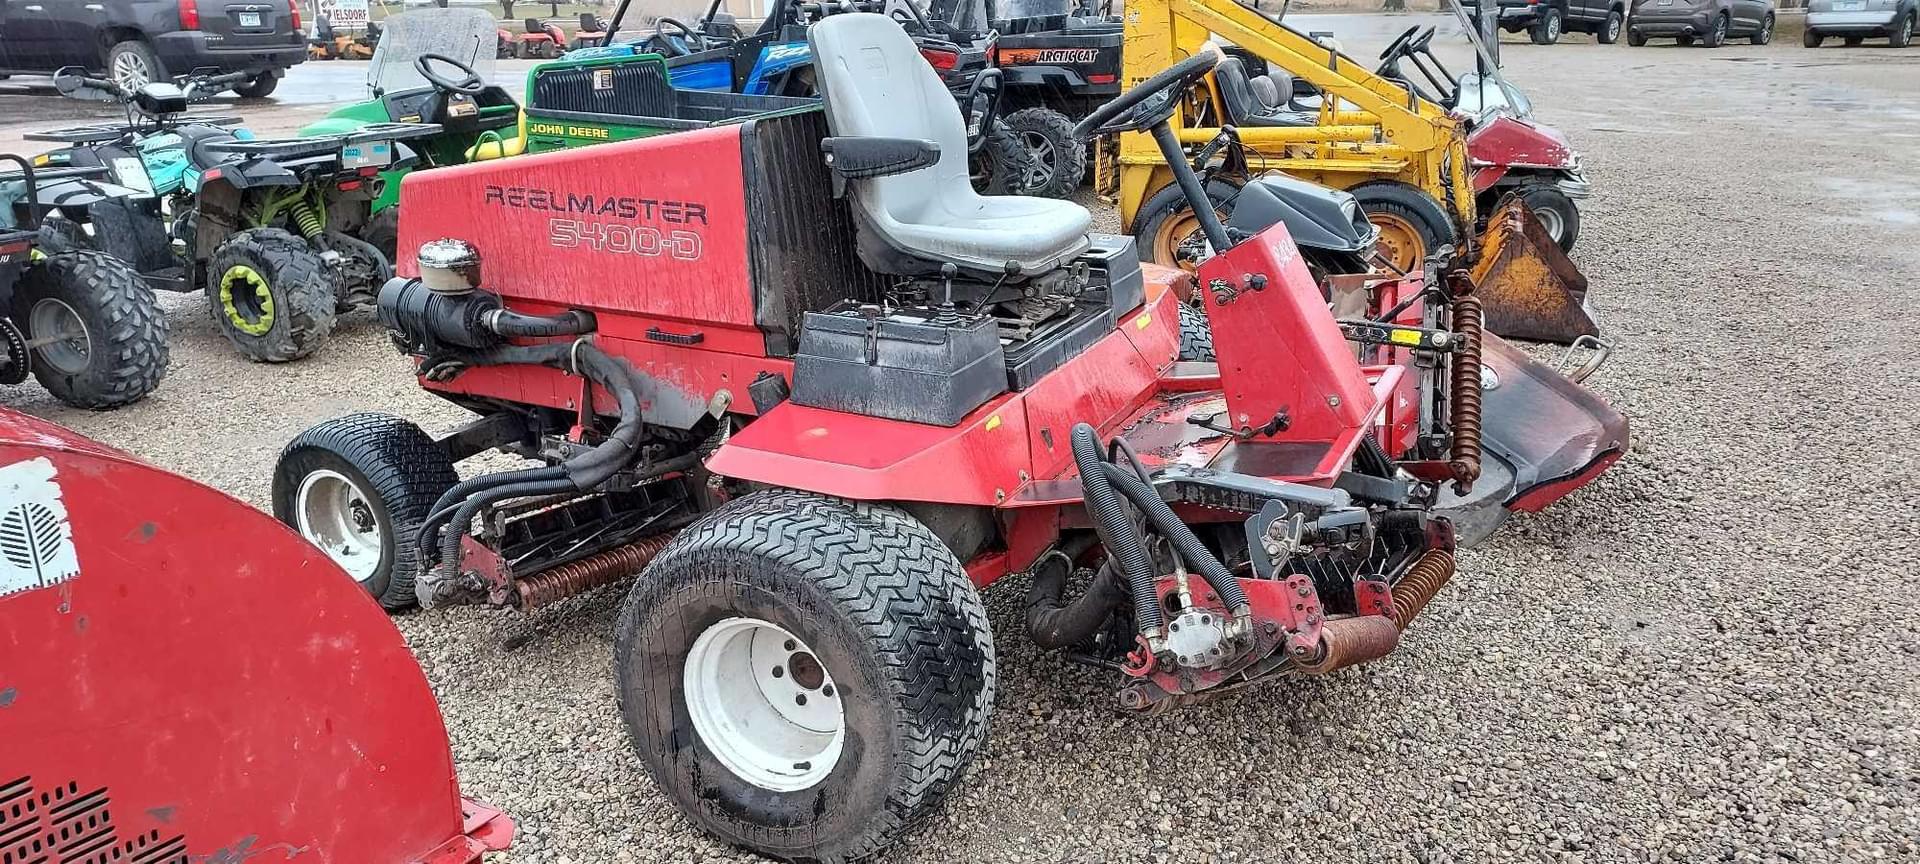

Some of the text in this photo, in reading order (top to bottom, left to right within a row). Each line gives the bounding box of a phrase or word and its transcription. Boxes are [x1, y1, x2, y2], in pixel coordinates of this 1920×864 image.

[1036, 48, 1077, 63] ARCTIC
[1076, 48, 1099, 63] CAT
[530, 123, 609, 138] JOHN DEERE
[485, 184, 708, 226] REELMASTER
[549, 217, 702, 261] 5400-D
